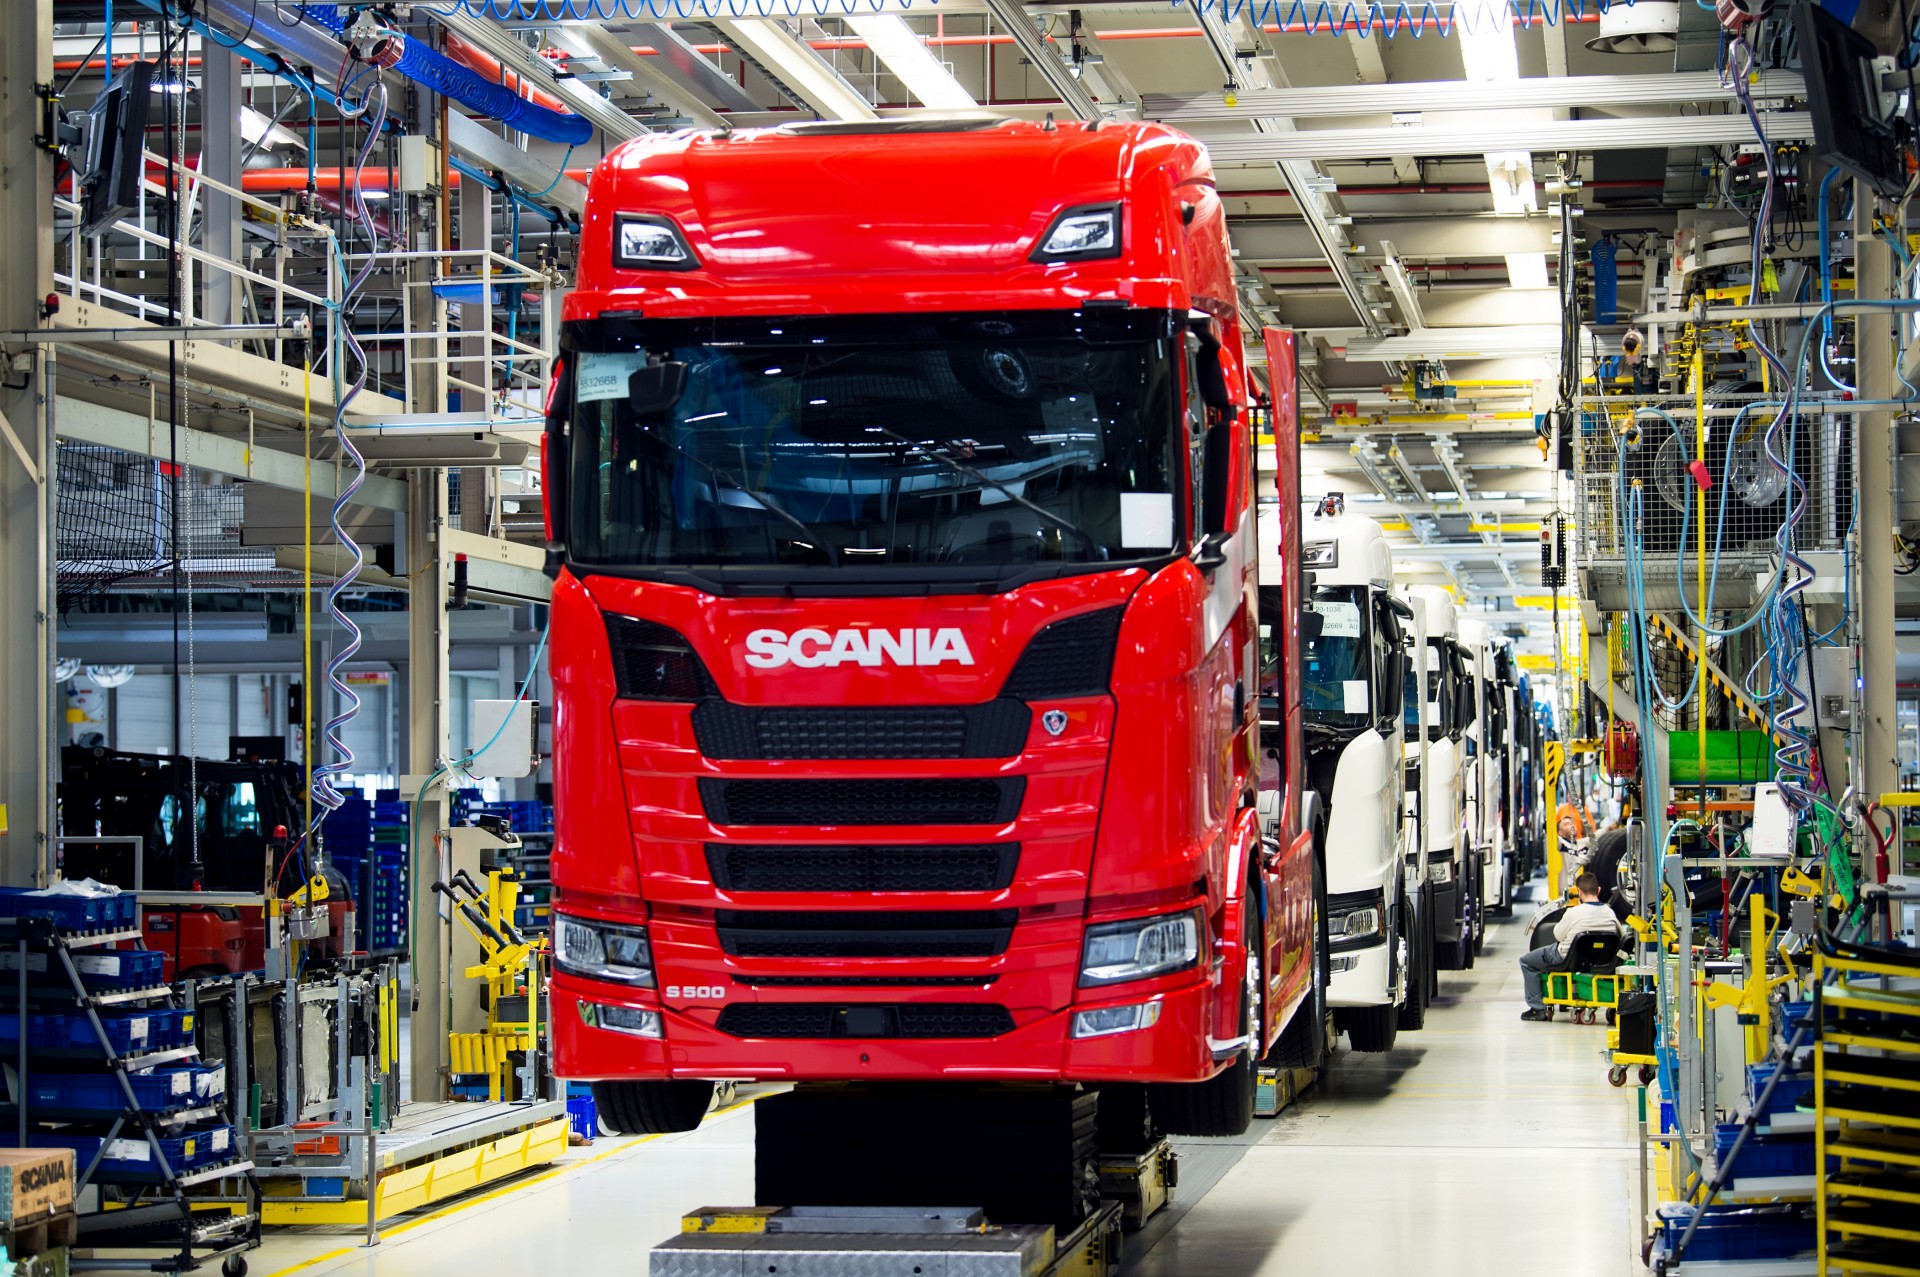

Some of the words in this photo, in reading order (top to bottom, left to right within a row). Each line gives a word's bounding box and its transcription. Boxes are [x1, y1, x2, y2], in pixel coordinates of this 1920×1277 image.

[744, 628, 975, 668] SCANIA
[666, 985, 680, 998] S
[683, 986, 725, 998] 500
[21, 1160, 65, 1193] SCANIA
